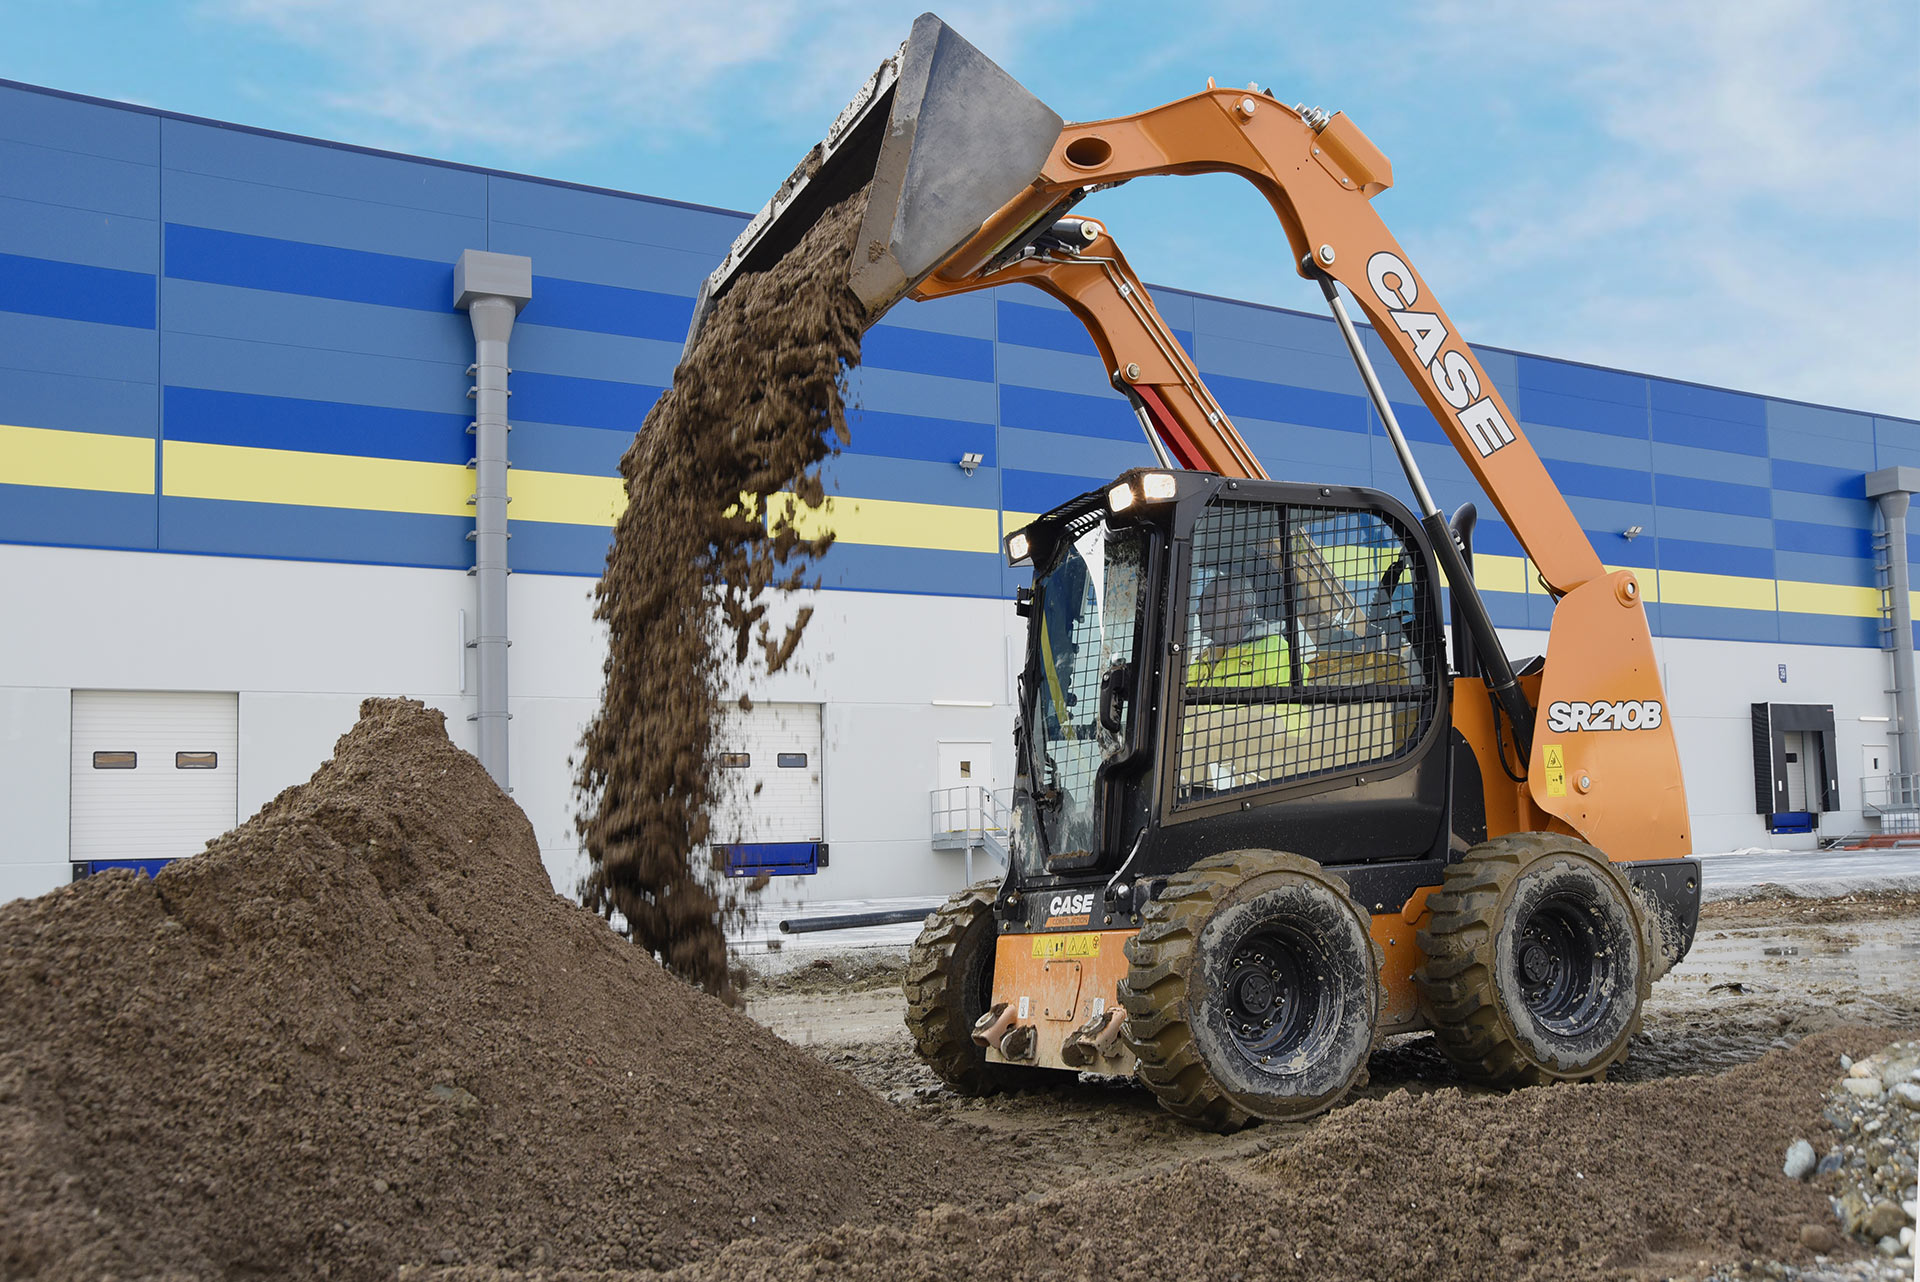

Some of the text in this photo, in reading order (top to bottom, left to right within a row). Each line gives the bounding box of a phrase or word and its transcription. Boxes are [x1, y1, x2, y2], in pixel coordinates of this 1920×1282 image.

[1366, 251, 1517, 458] CASE
[1547, 700, 1662, 733] SR210B
[1050, 893, 1095, 915] CASE
